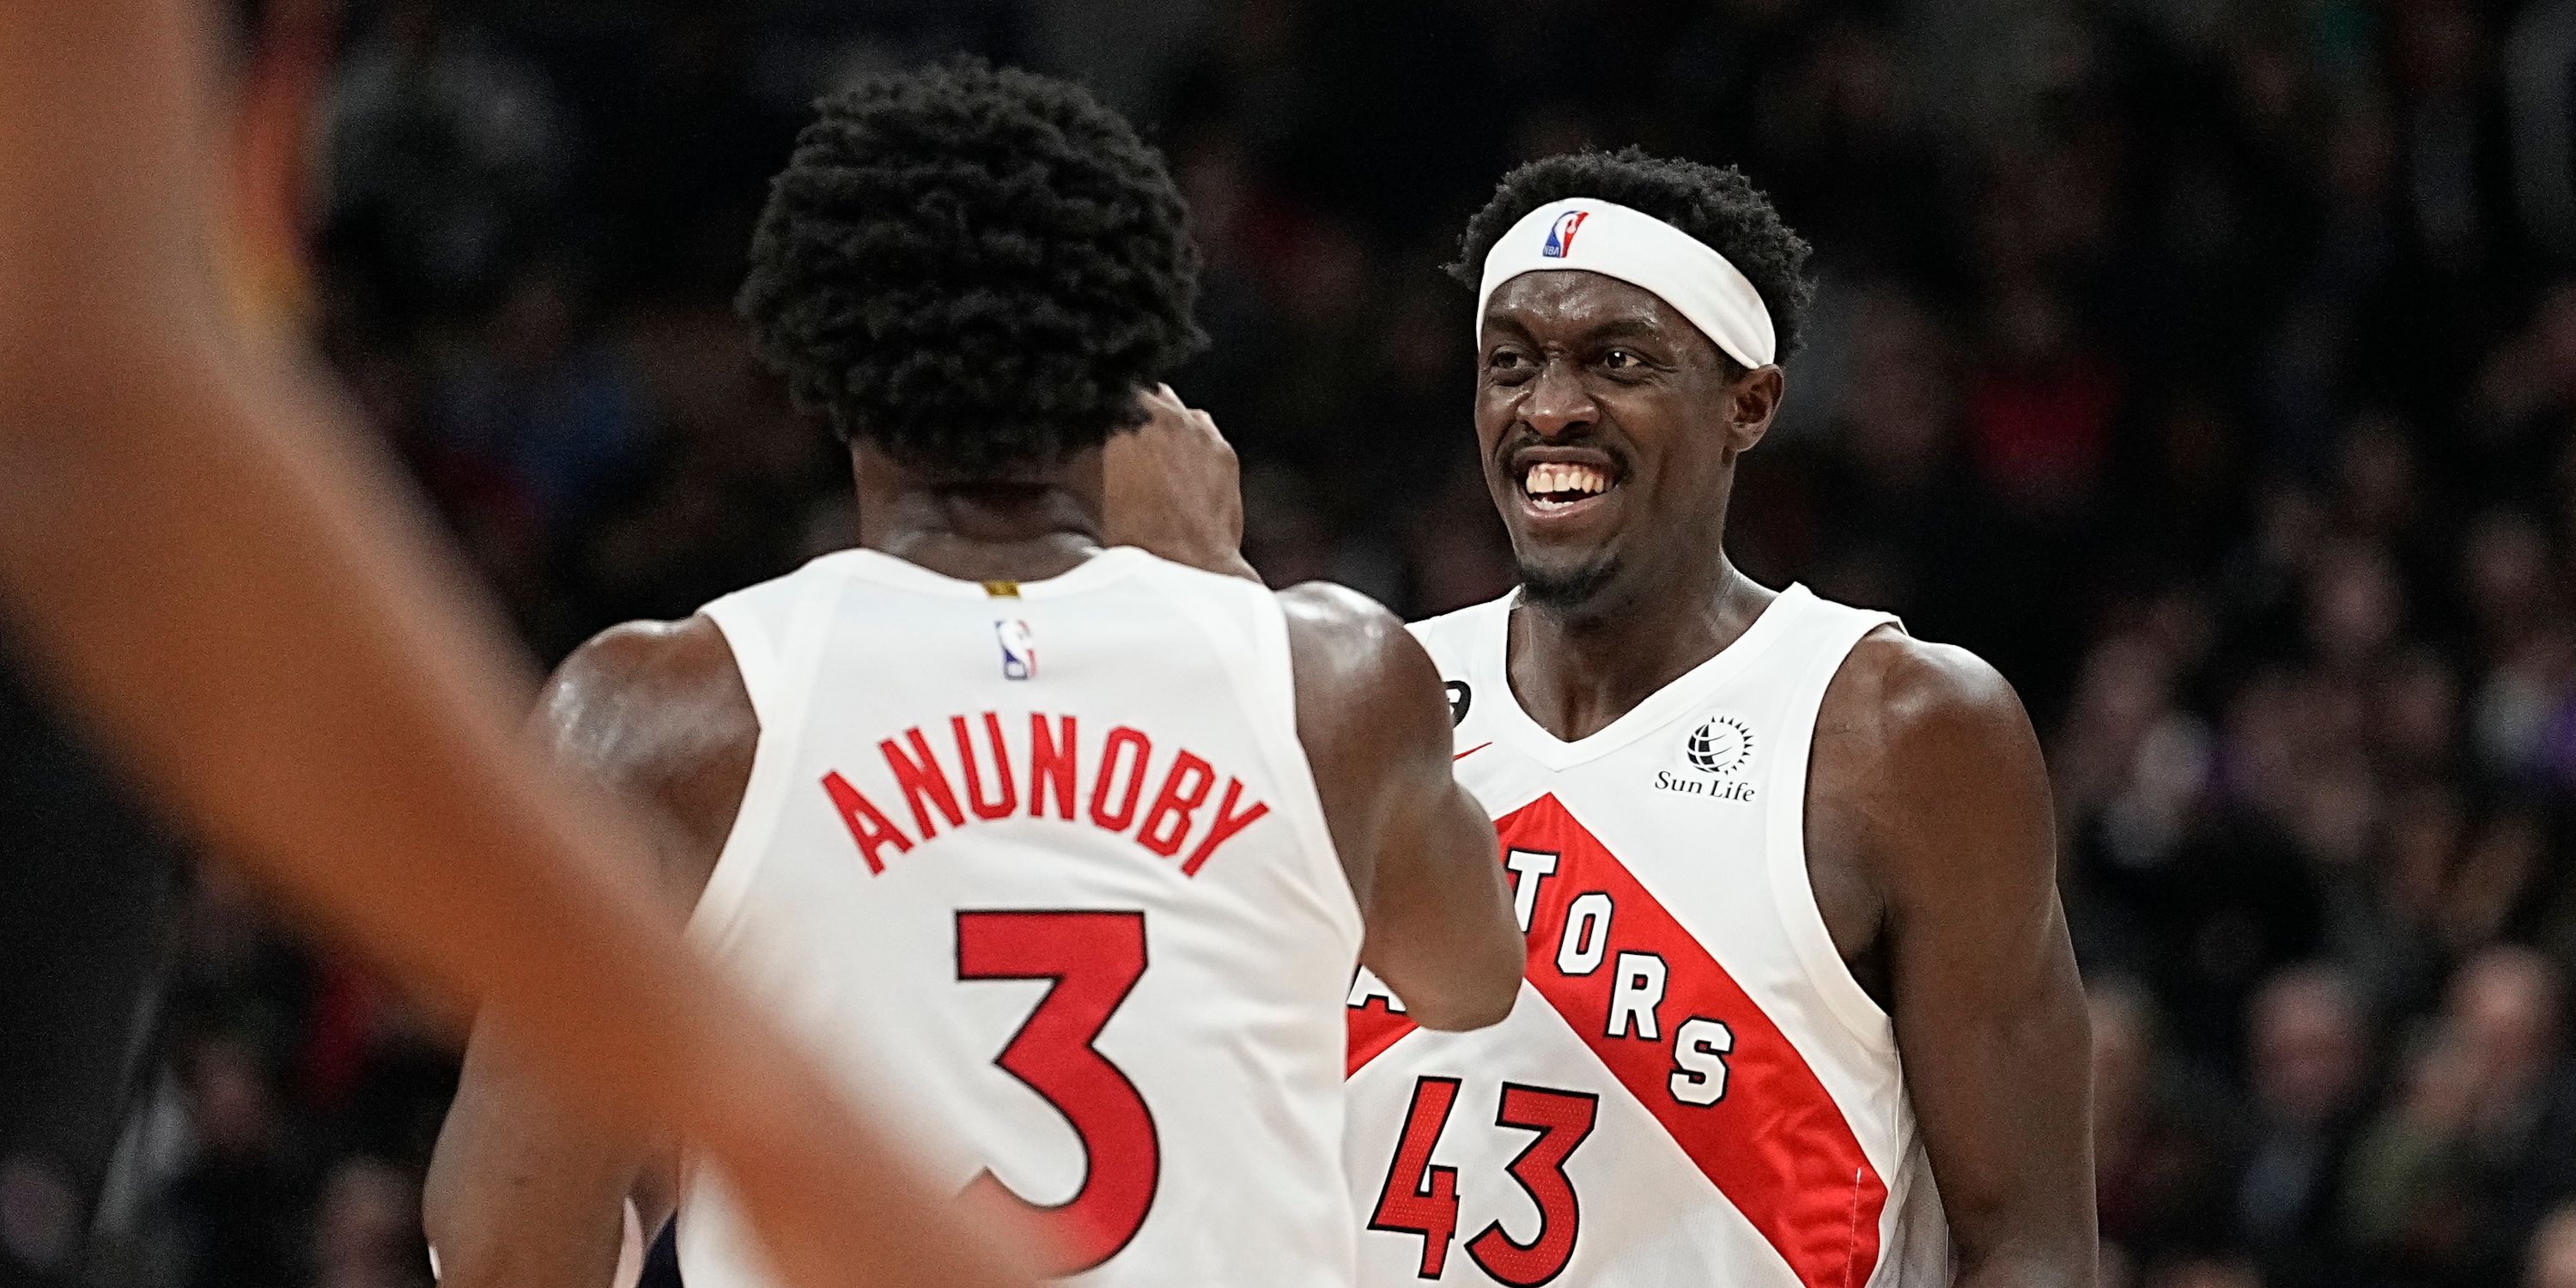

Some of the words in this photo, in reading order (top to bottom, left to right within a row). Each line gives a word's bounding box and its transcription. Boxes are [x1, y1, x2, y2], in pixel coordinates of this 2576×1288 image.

[1543, 245, 1559, 256] NBA
[819, 711, 1269, 878] ANUNOBY
[1655, 770, 1703, 795] Sun
[1709, 780, 1755, 802] Life
[954, 908, 1161, 1279] 3
[1366, 1075, 1600, 1288] 43
